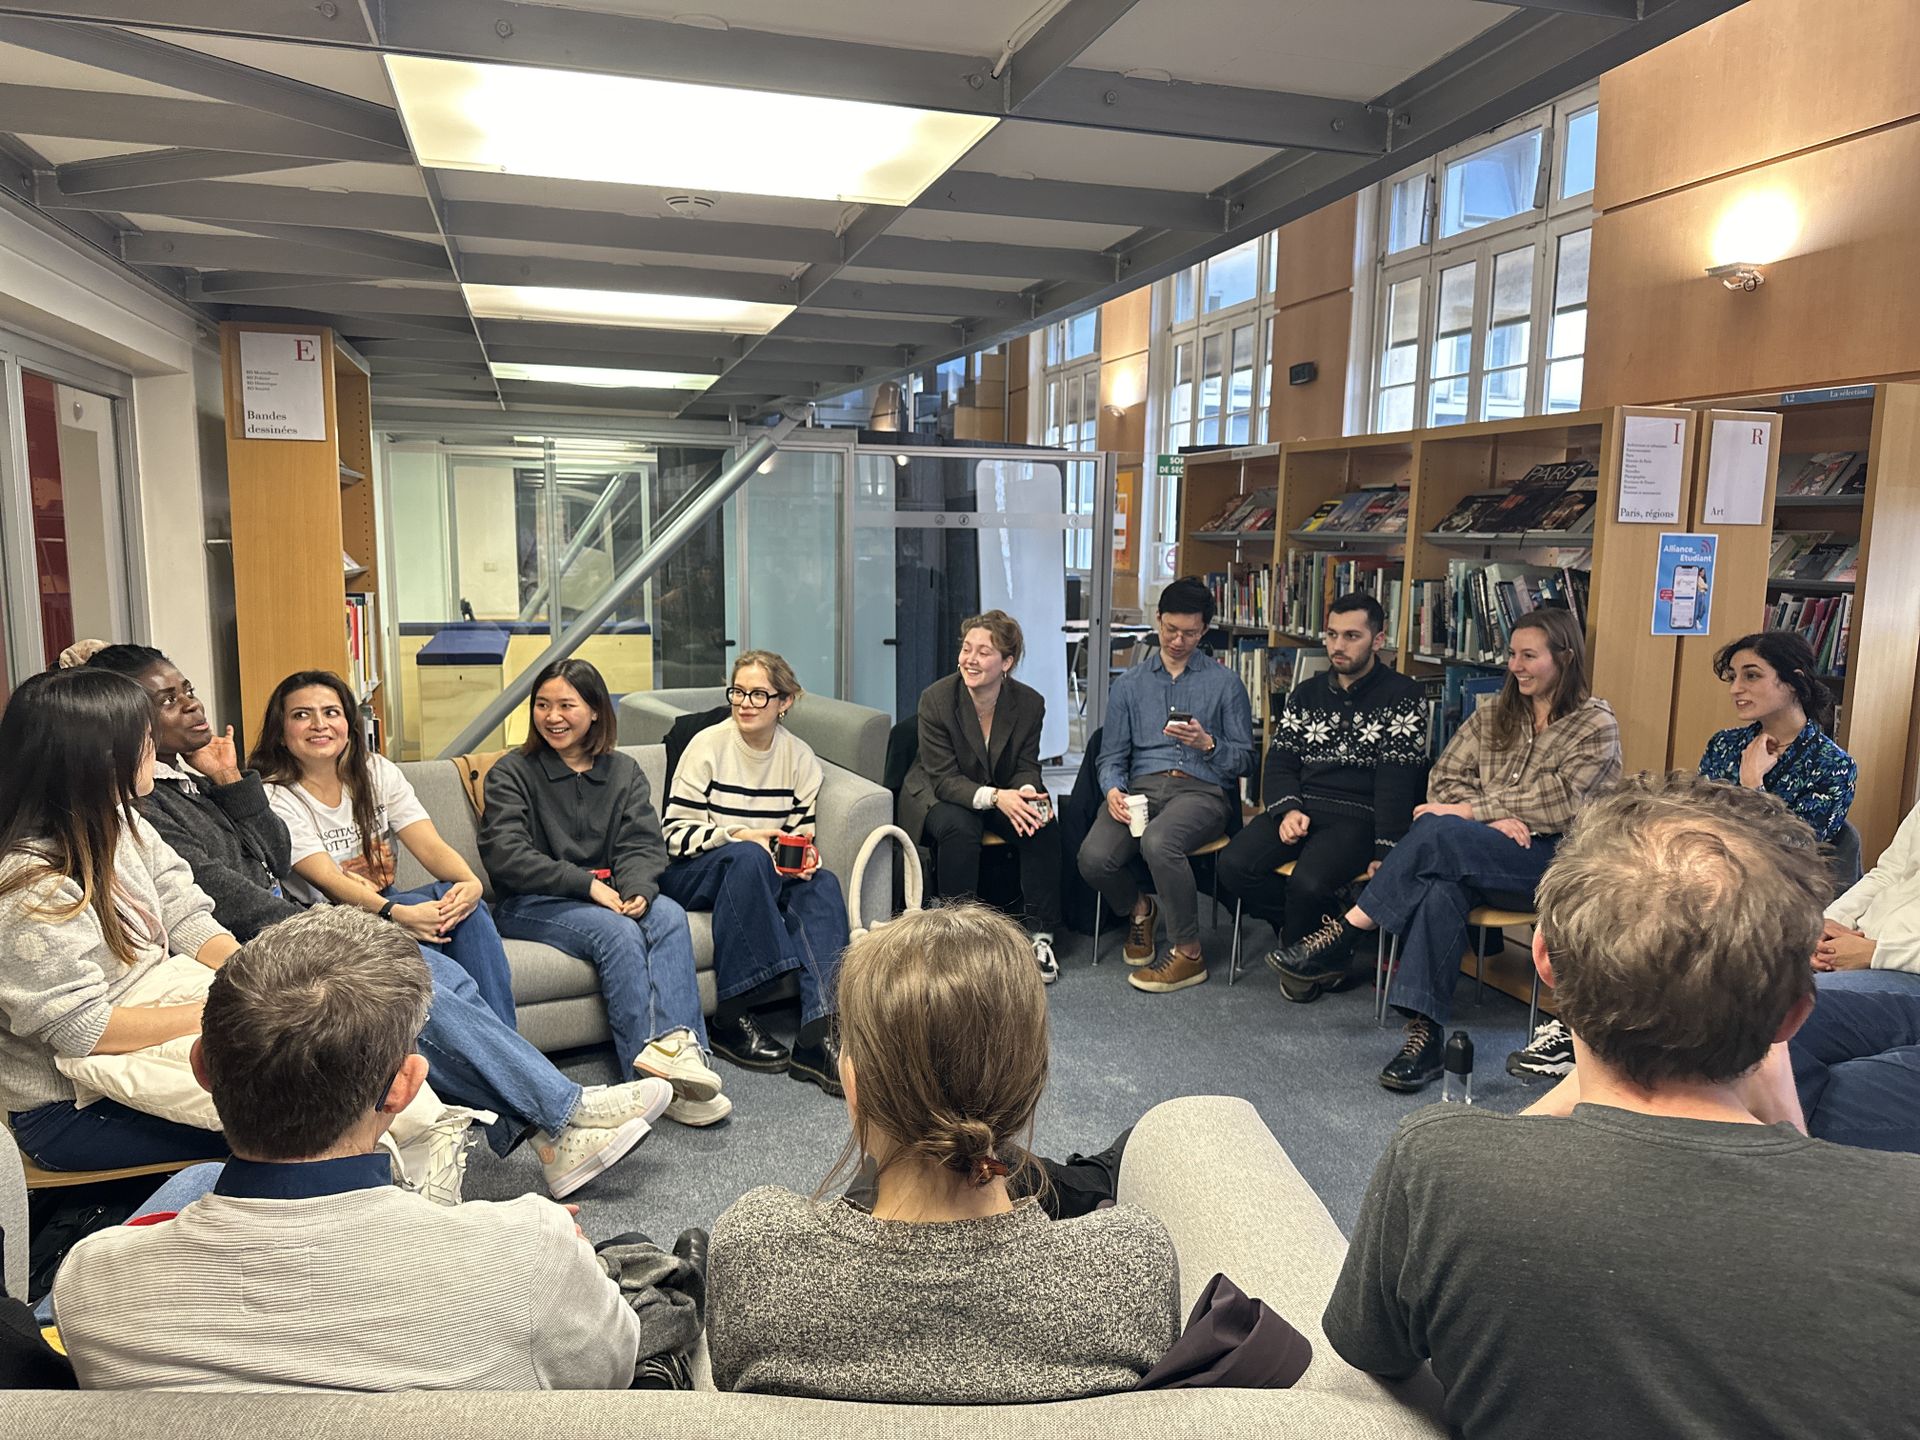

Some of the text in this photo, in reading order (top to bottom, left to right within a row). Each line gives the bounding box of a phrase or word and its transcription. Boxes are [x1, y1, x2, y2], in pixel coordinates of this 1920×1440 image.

[294, 338, 315, 362] E
[1784, 394, 1795, 403] A2
[1829, 388, 1868, 398] La sélection
[247, 410, 287, 420] Bandes
[247, 424, 298, 435] dessinées
[1672, 423, 1681, 445] I
[1752, 428, 1763, 445] R
[1159, 466, 1169, 474] DE
[1525, 464, 1583, 481] PARIS
[1620, 507, 1674, 520] Paris, régions
[1710, 507, 1724, 516] Art
